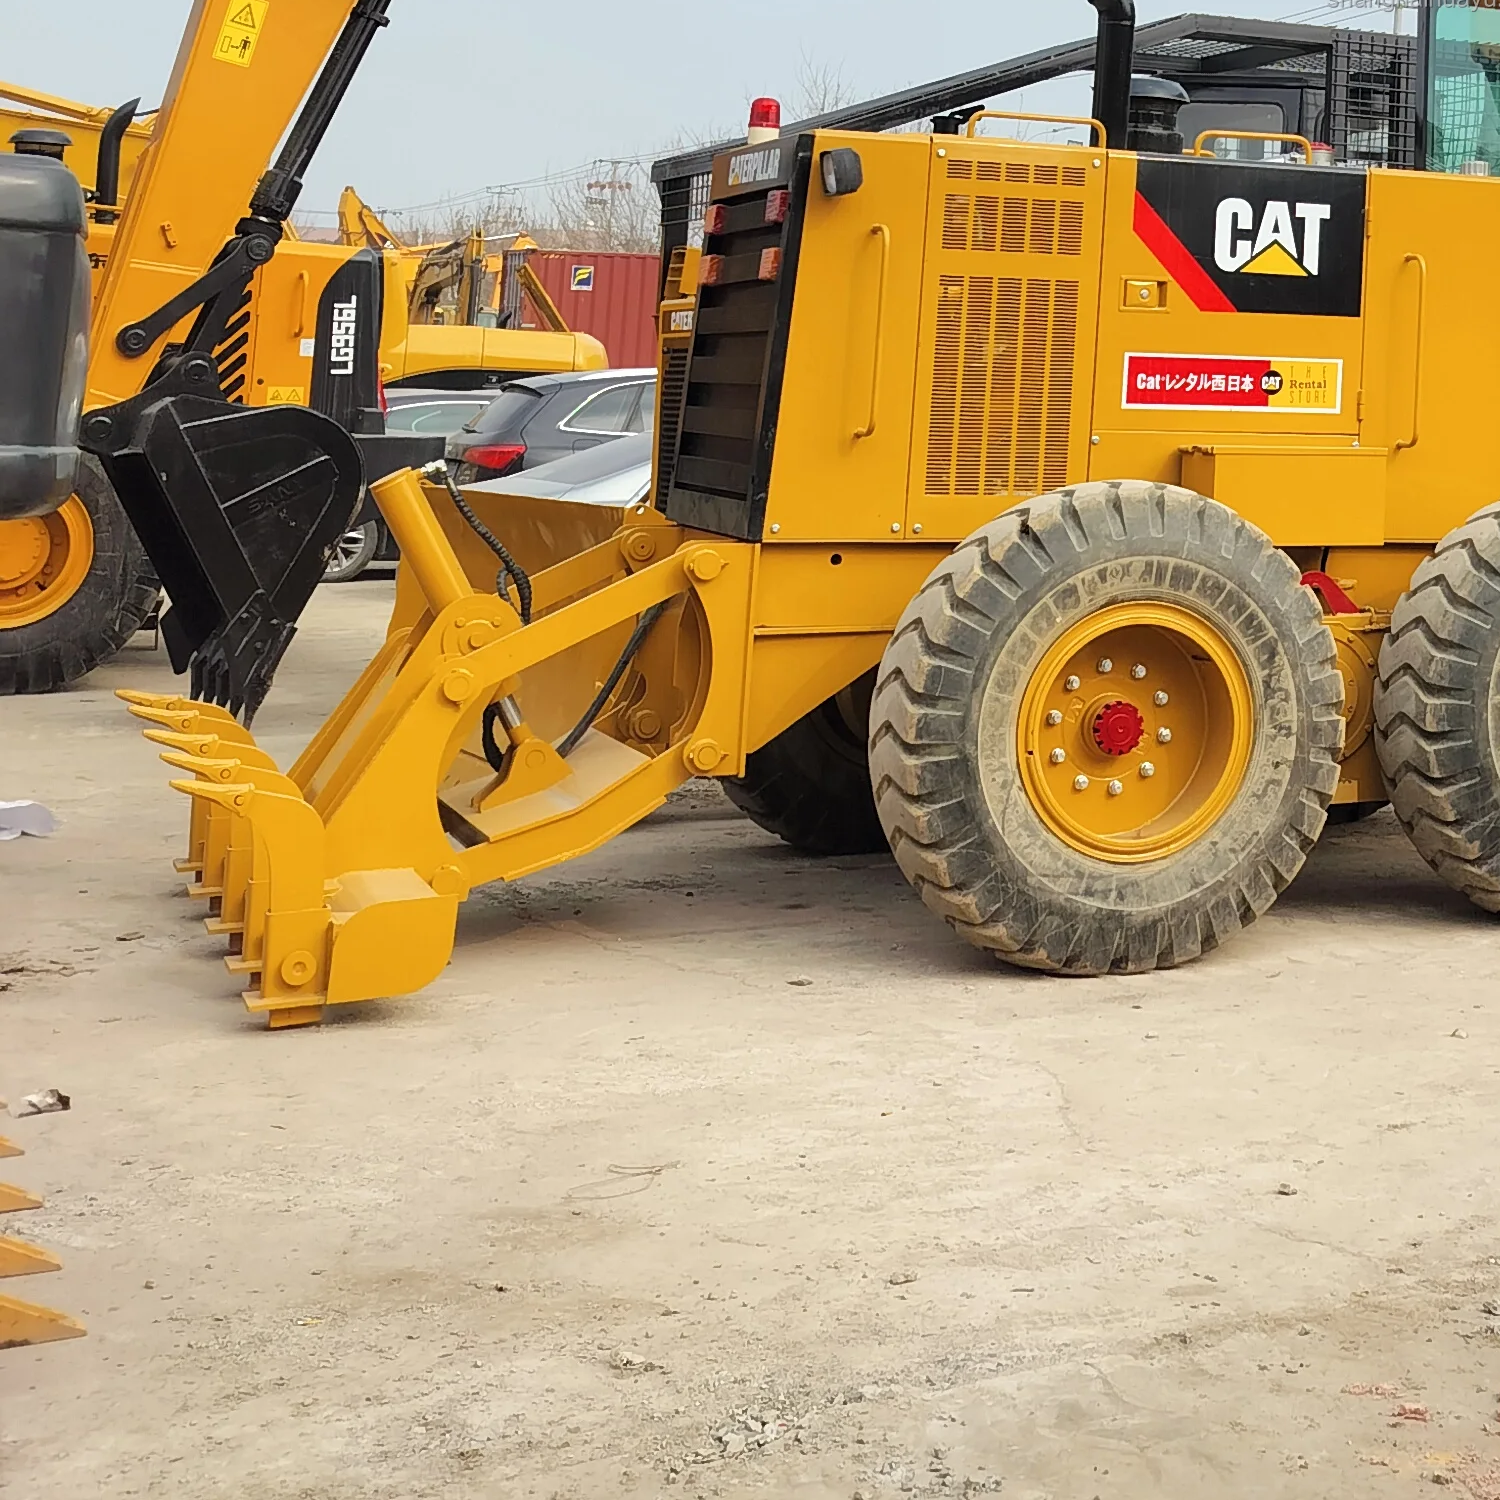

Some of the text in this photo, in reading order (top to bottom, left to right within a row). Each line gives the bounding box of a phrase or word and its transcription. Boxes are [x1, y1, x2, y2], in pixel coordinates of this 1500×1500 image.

[728, 148, 781, 186] CATERPILLAR
[1213, 197, 1332, 276] CAT
[330, 294, 358, 375] LG956L
[1260, 375, 1282, 391] CAT
[1289, 379, 1328, 389] Rental
[1289, 390, 1328, 404] STORE
